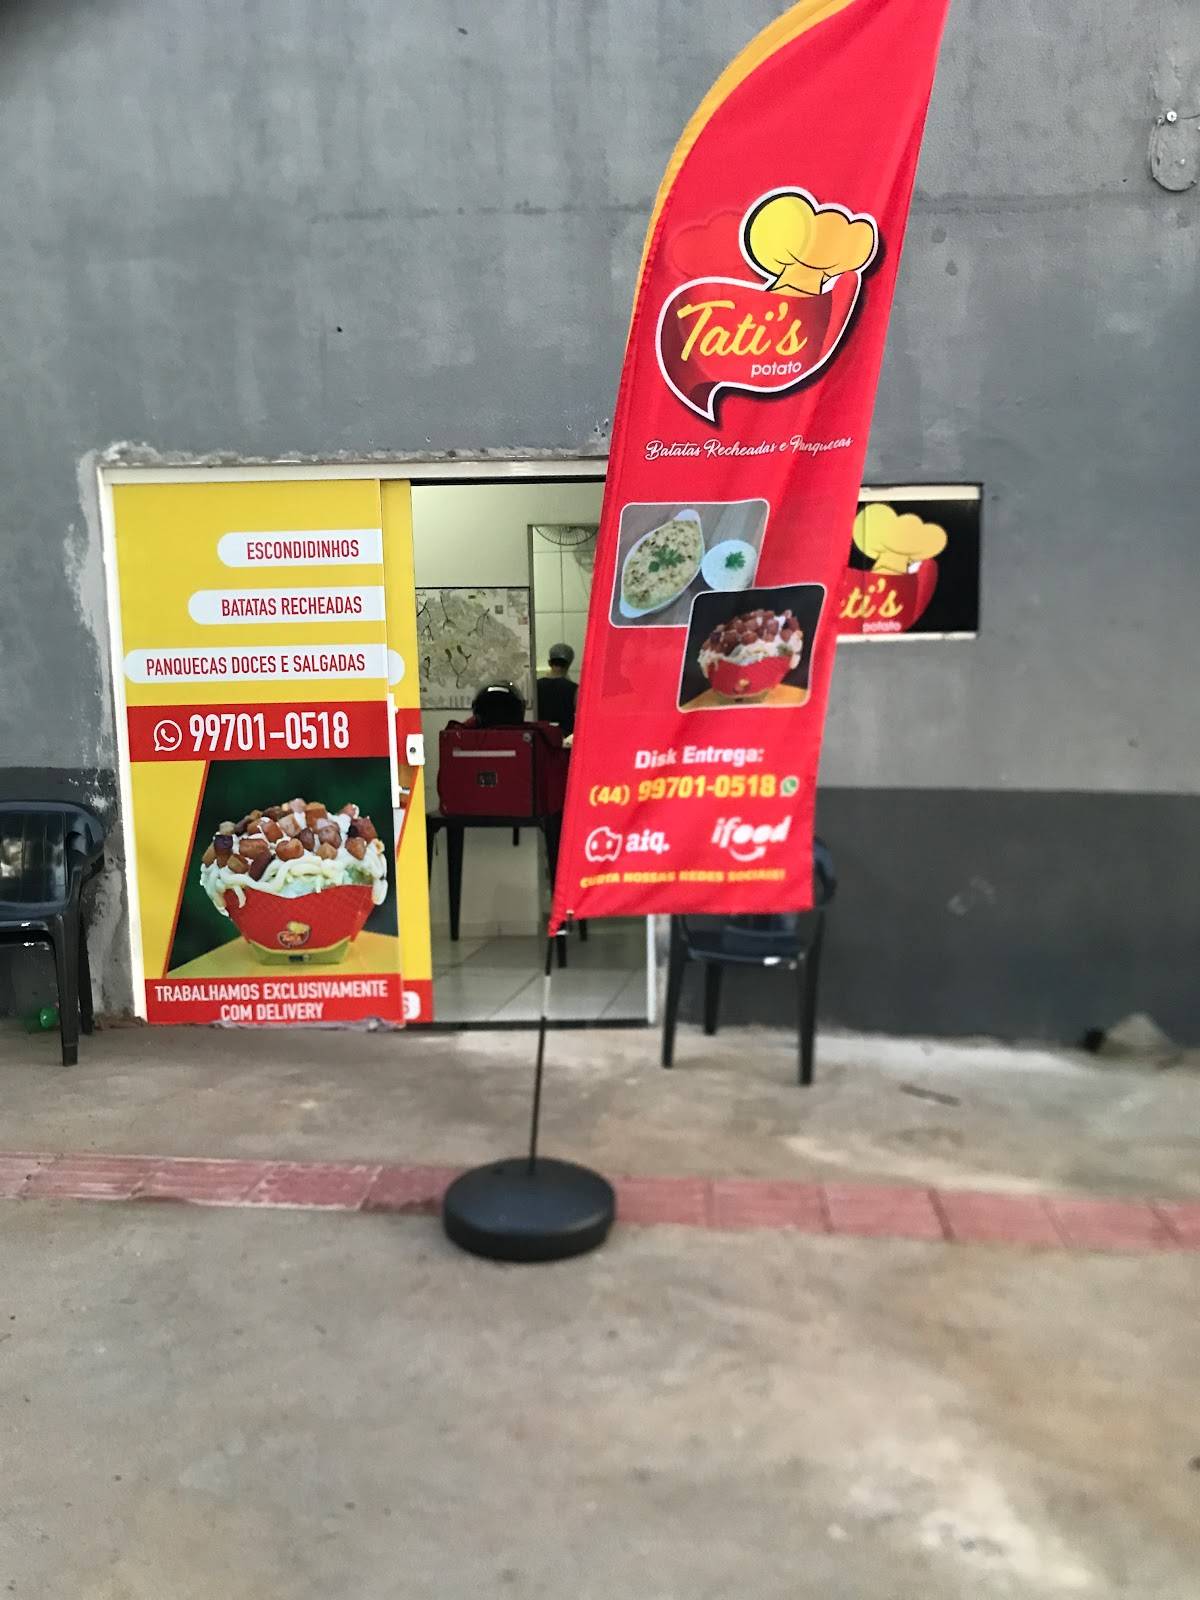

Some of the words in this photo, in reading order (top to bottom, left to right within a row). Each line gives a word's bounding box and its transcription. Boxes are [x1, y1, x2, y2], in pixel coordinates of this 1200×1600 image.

[677, 300, 807, 362] Tati's
[751, 361, 802, 378] potato
[645, 440, 700, 461] Batatas
[703, 439, 775, 459] Recheadas
[779, 443, 788, 452] e
[789, 435, 853, 457] Panquecas
[247, 539, 360, 560] ESCONDIDINHOS
[222, 597, 277, 617] BATATAS
[281, 595, 363, 615] RECHEADAS
[839, 578, 904, 618] ti's
[146, 657, 227, 676] PANQUECAS
[232, 655, 277, 674] DOCES
[281, 655, 289, 672] E
[293, 653, 366, 672] SALGADAS
[189, 710, 350, 752] 99701-0518
[634, 748, 677, 769] Disk
[682, 745, 765, 768] Entrega:
[589, 784, 630, 806] (44)
[638, 774, 776, 801] 99701-0518
[155, 982, 260, 1002] TRABALHAMOS
[263, 980, 388, 1000] EXCLUSIVAMENTE
[220, 1004, 253, 1022] COM
[256, 1001, 325, 1021] DELIVERY
